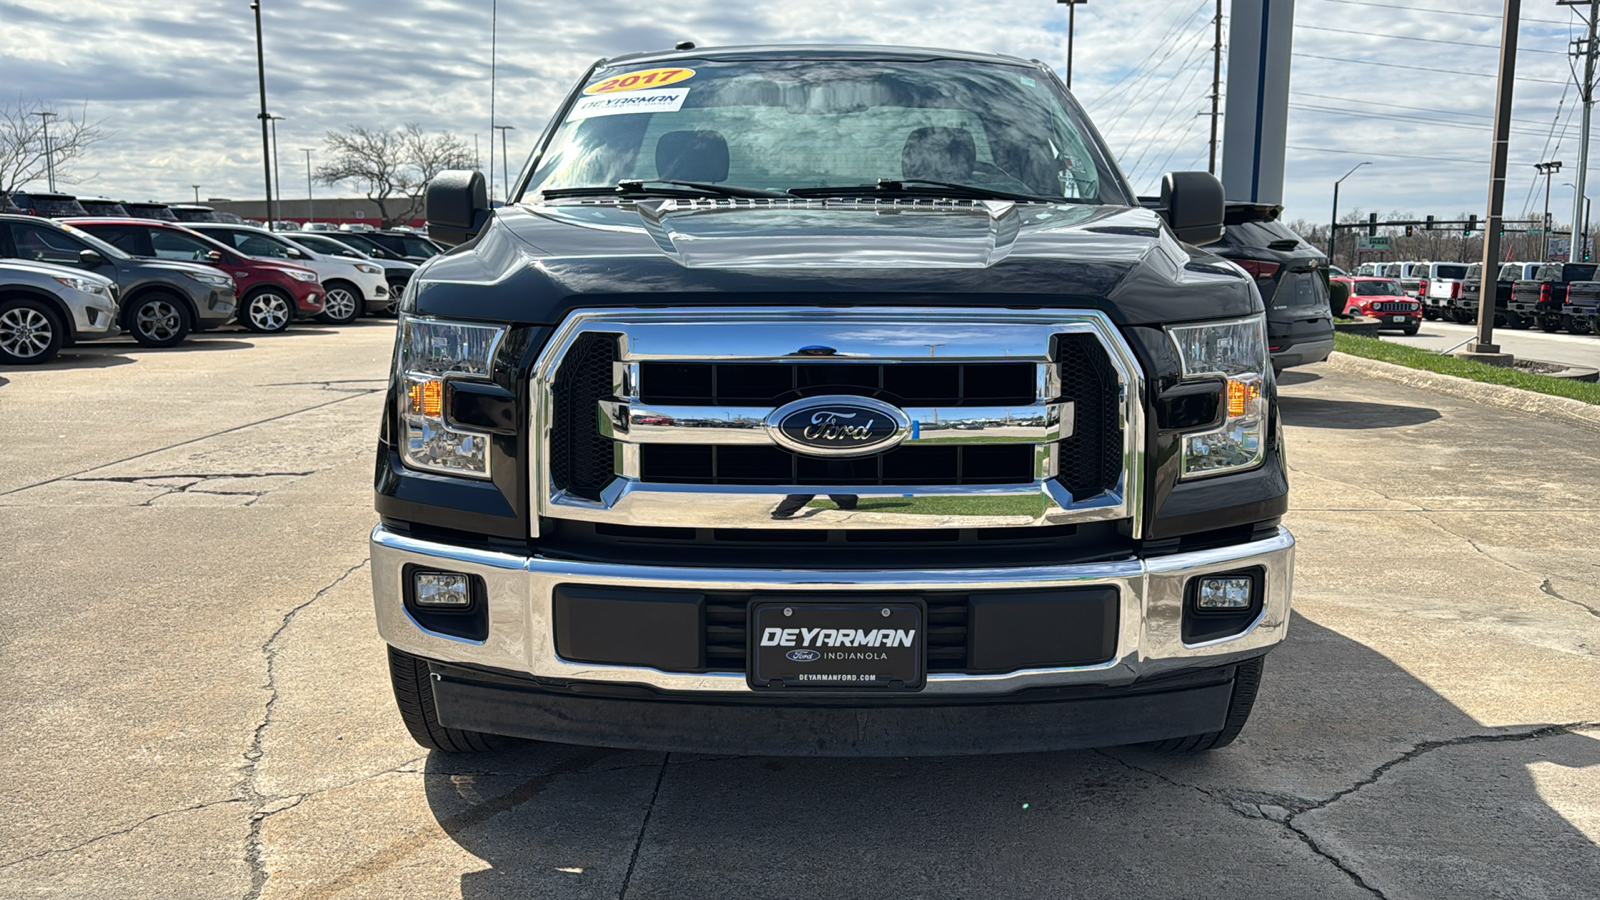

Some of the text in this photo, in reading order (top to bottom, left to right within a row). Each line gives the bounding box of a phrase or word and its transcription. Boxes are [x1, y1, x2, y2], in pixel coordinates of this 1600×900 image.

[596, 70, 684, 92] 2017
[582, 95, 681, 109] DEYARMAN
[803, 411, 874, 440] Ford
[760, 627, 916, 647] DEYARMAN
[792, 650, 888, 660] Ford INDIANOLA
[799, 674, 876, 682] DEYARMANFORD.COM
